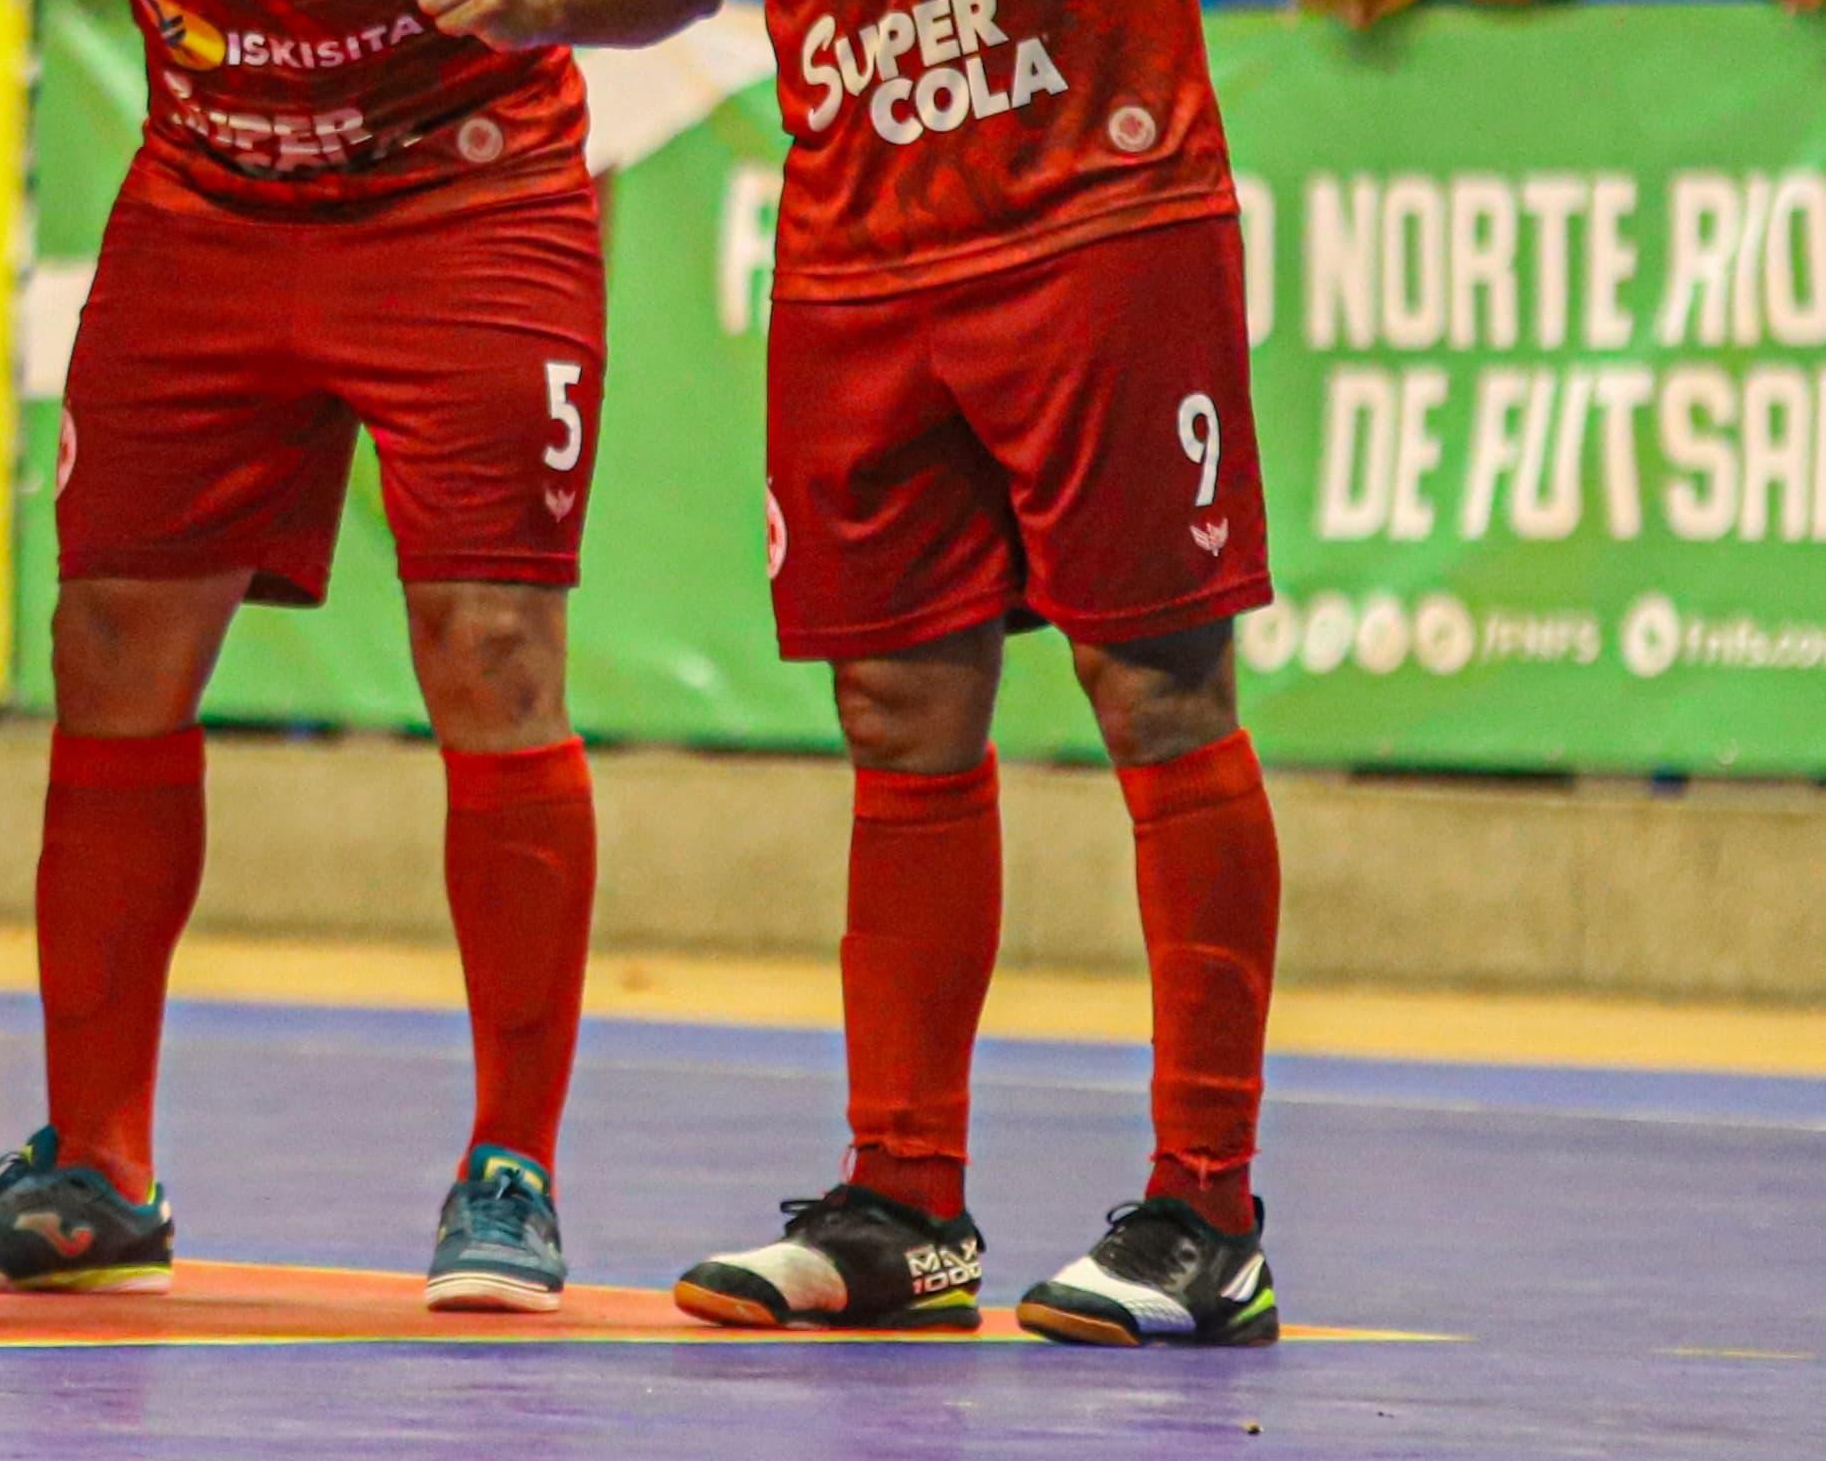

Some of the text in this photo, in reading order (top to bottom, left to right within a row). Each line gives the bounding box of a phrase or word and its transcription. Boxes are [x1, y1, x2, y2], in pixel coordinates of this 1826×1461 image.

[227, 13, 424, 69] ISKISITA
[870, 37, 1070, 145] COLA
[1306, 174, 1638, 349] NORTE
[543, 363, 583, 471] 5
[1178, 393, 1221, 507] 9
[1320, 365, 1448, 540] DE
